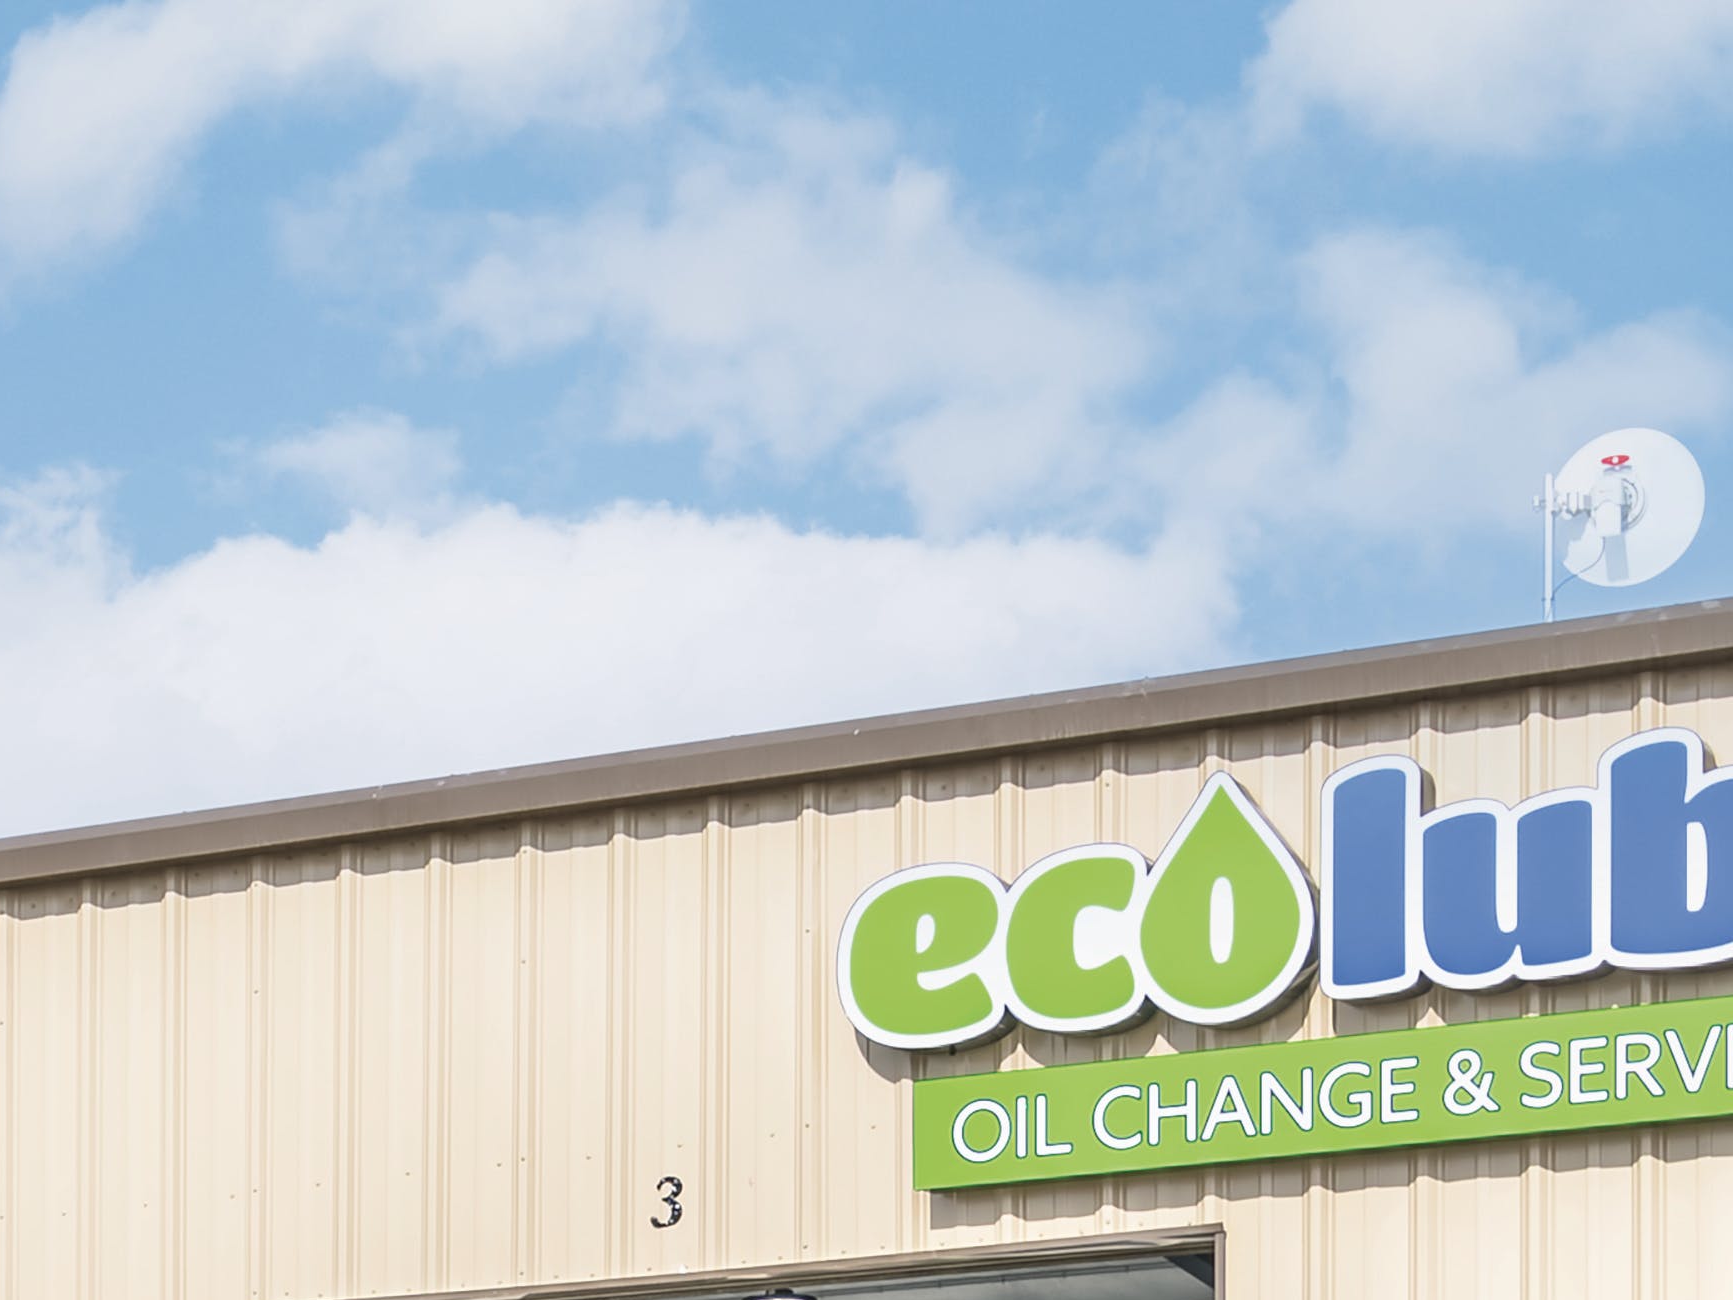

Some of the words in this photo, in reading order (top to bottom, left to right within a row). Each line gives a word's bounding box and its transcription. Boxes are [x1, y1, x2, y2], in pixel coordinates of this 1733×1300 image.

[951, 1096, 1072, 1164] OIL
[1091, 1051, 1421, 1151] CHANGE
[1441, 1047, 1500, 1117] &
[649, 1176, 683, 1229] 3
